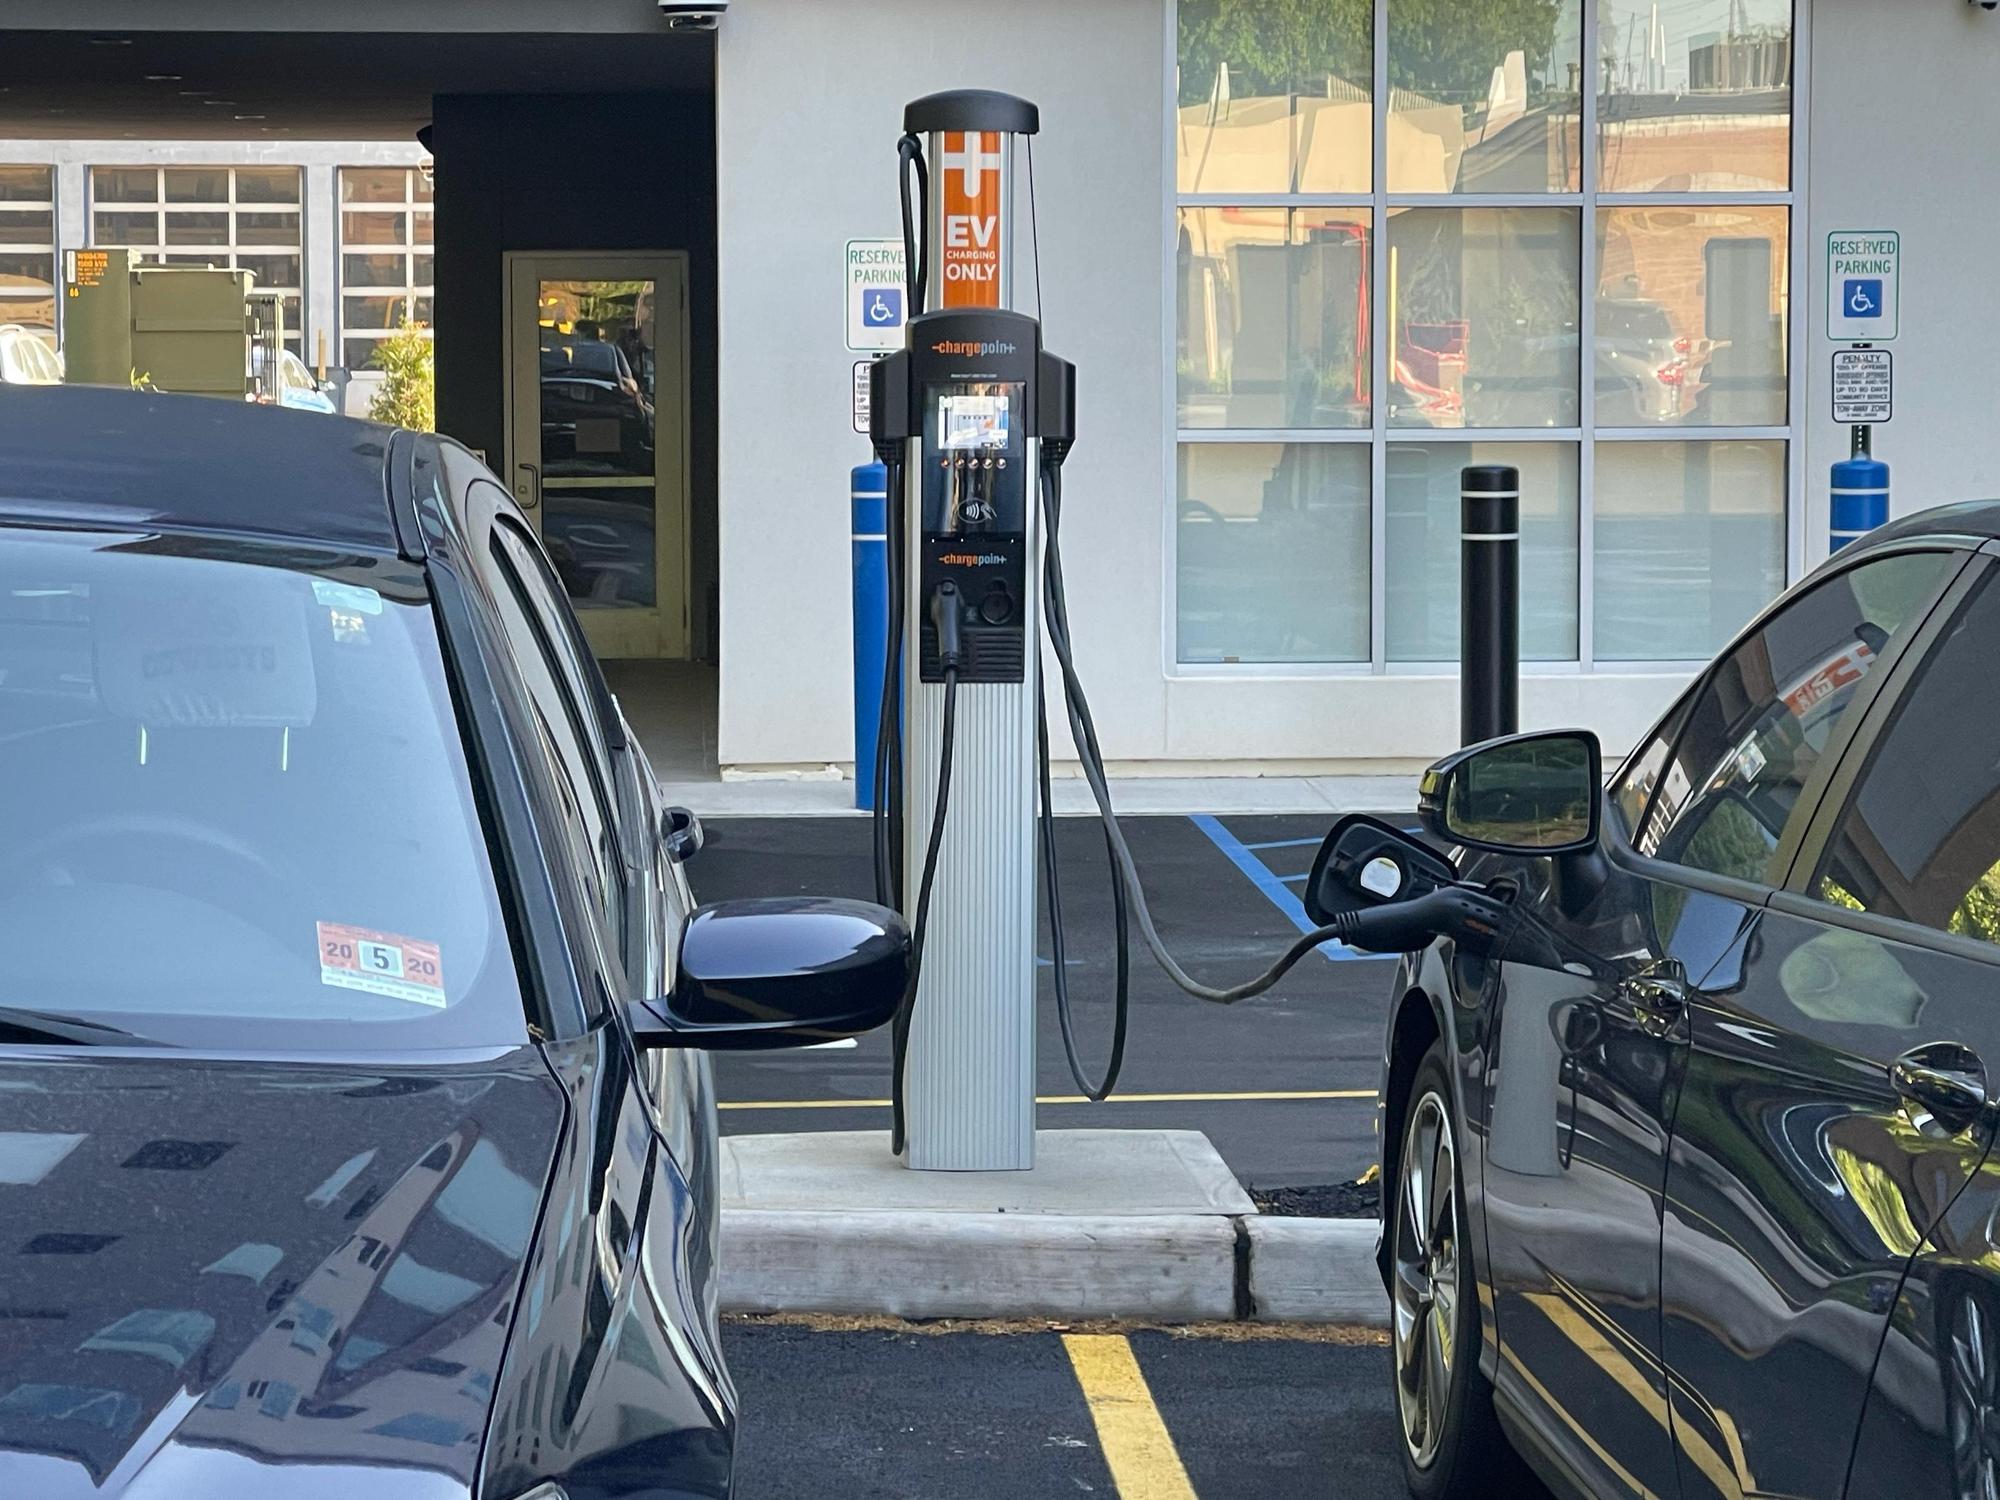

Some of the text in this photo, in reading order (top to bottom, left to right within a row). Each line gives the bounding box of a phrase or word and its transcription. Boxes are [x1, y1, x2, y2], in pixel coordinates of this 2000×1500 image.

[947, 215, 997, 247] EV
[1831, 241, 1896, 255] RESERVED
[850, 250, 905, 264] RESERVE
[946, 251, 996, 260] CHARGING
[946, 263, 997, 281] ONLY
[1835, 260, 1891, 274] PARKING
[1842, 354, 1881, 363] PENALTY
[326, 942, 352, 959] 20
[372, 947, 389, 970] 5
[407, 958, 436, 976] 20
